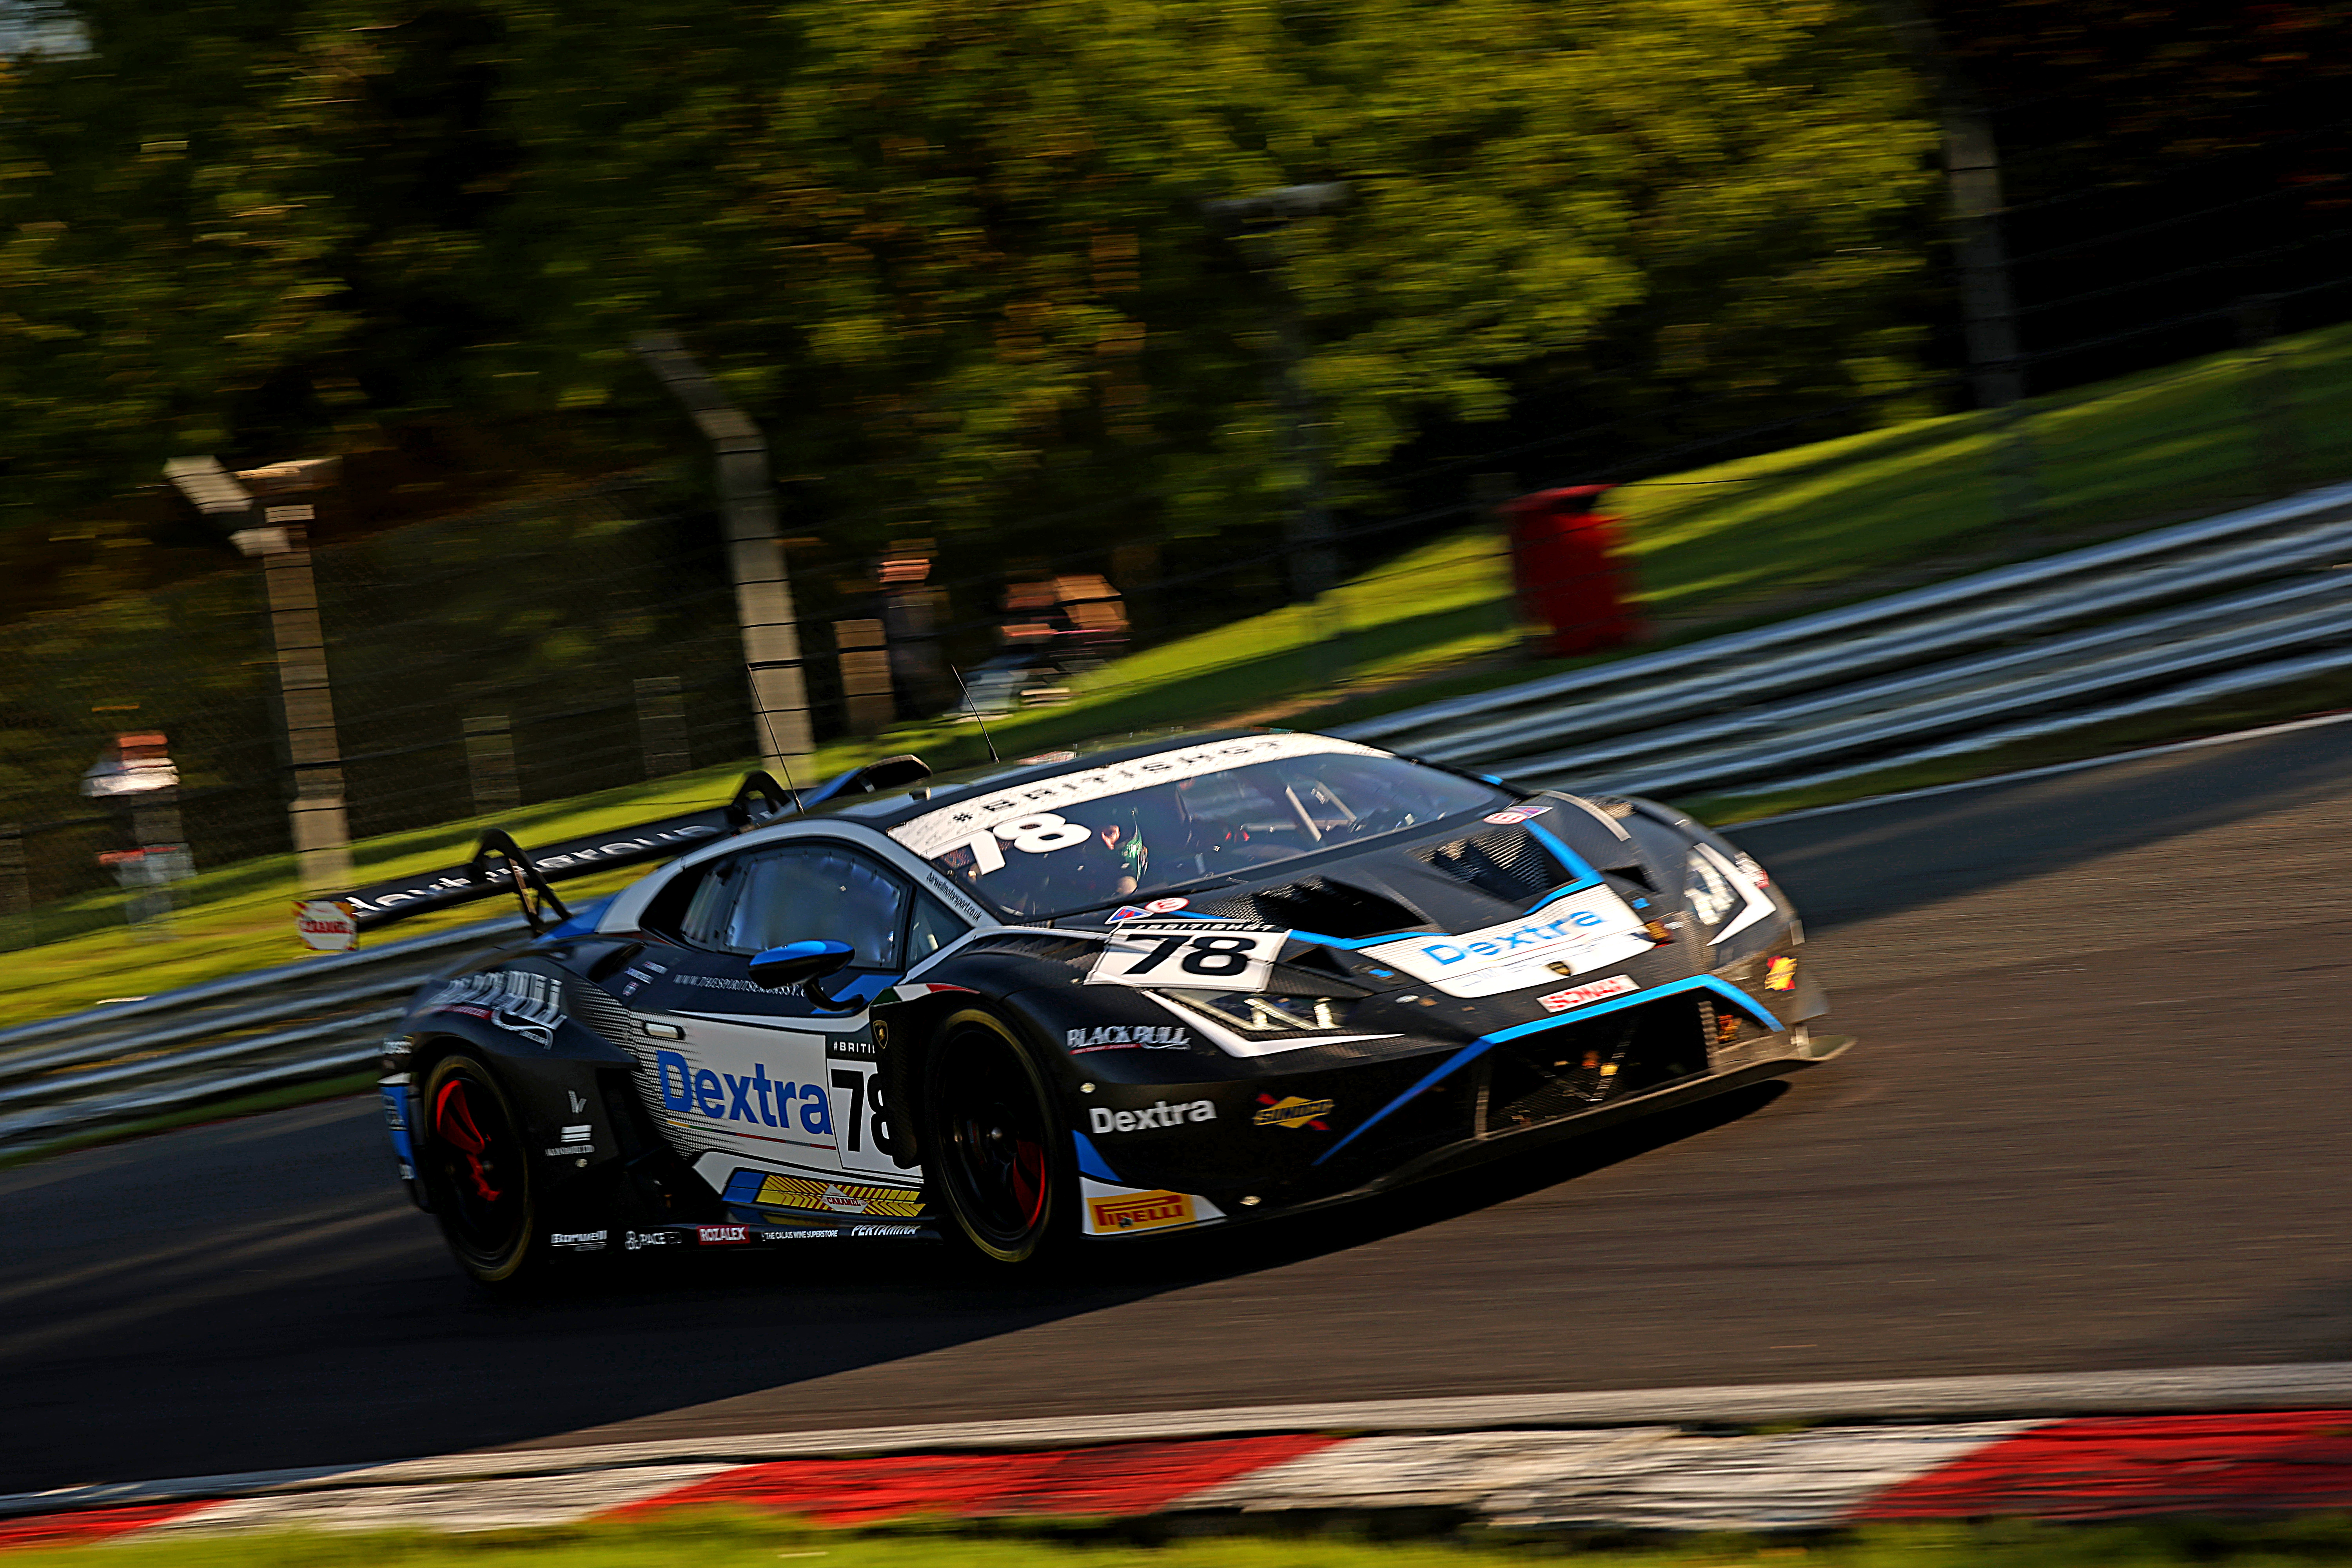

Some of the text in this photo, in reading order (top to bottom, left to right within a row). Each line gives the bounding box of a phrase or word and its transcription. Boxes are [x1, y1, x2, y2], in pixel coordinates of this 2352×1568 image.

[952, 739, 1283, 823] #BRITISHGT
[926, 812, 1092, 875] 78
[926, 871, 982, 922] barwellmotorsport.co.uk
[1121, 934, 1256, 975] 78
[1422, 911, 1602, 965] Dextra
[1066, 1026, 1192, 1048] BLACK BULL
[657, 1050, 833, 1135] Dextra
[1090, 1100, 1218, 1133] Dextra
[827, 1197, 861, 1207] CARAMEL
[1094, 1195, 1185, 1226] PIRELLI
[700, 1227, 747, 1241] ROZALEX
[807, 1230, 838, 1238] SUPERSTORE
[851, 1224, 921, 1236] PERTAMINA
